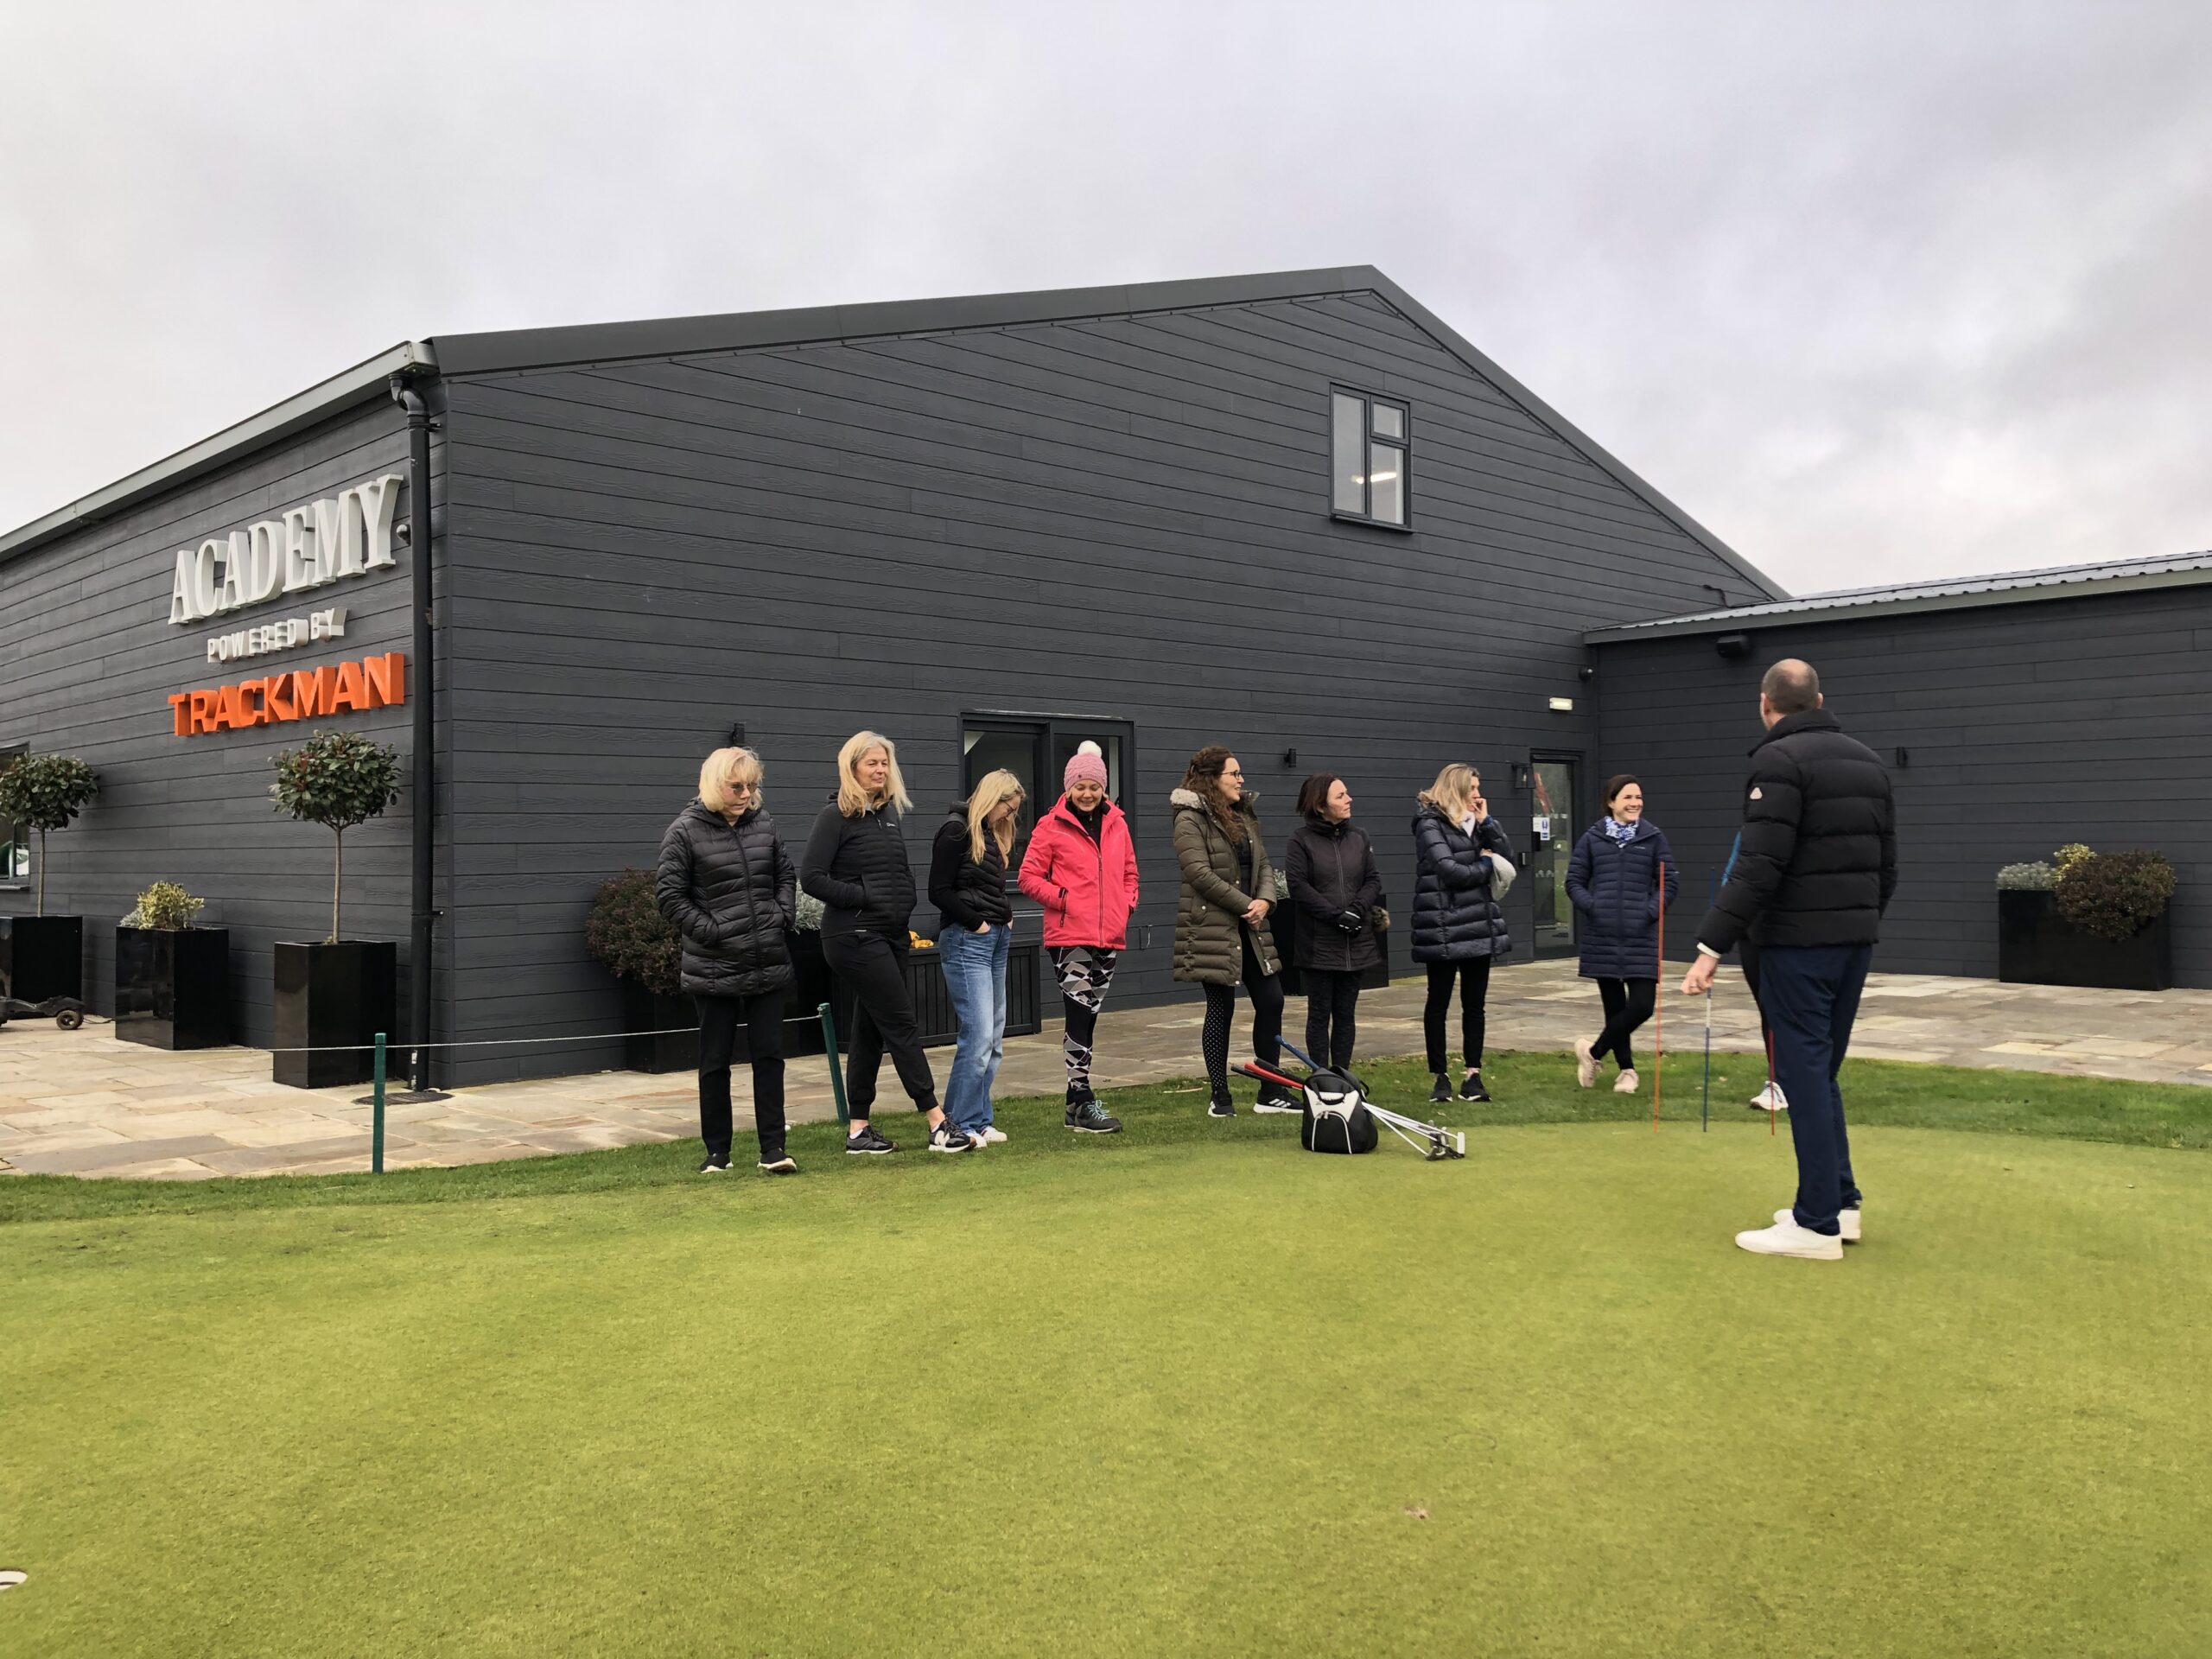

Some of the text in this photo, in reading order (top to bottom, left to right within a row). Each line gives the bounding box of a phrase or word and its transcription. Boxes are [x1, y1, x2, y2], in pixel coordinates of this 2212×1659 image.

[168, 474, 404, 625] ACADEMY
[207, 607, 347, 664] POWERED BY
[168, 652, 404, 736] TRACKMAN
